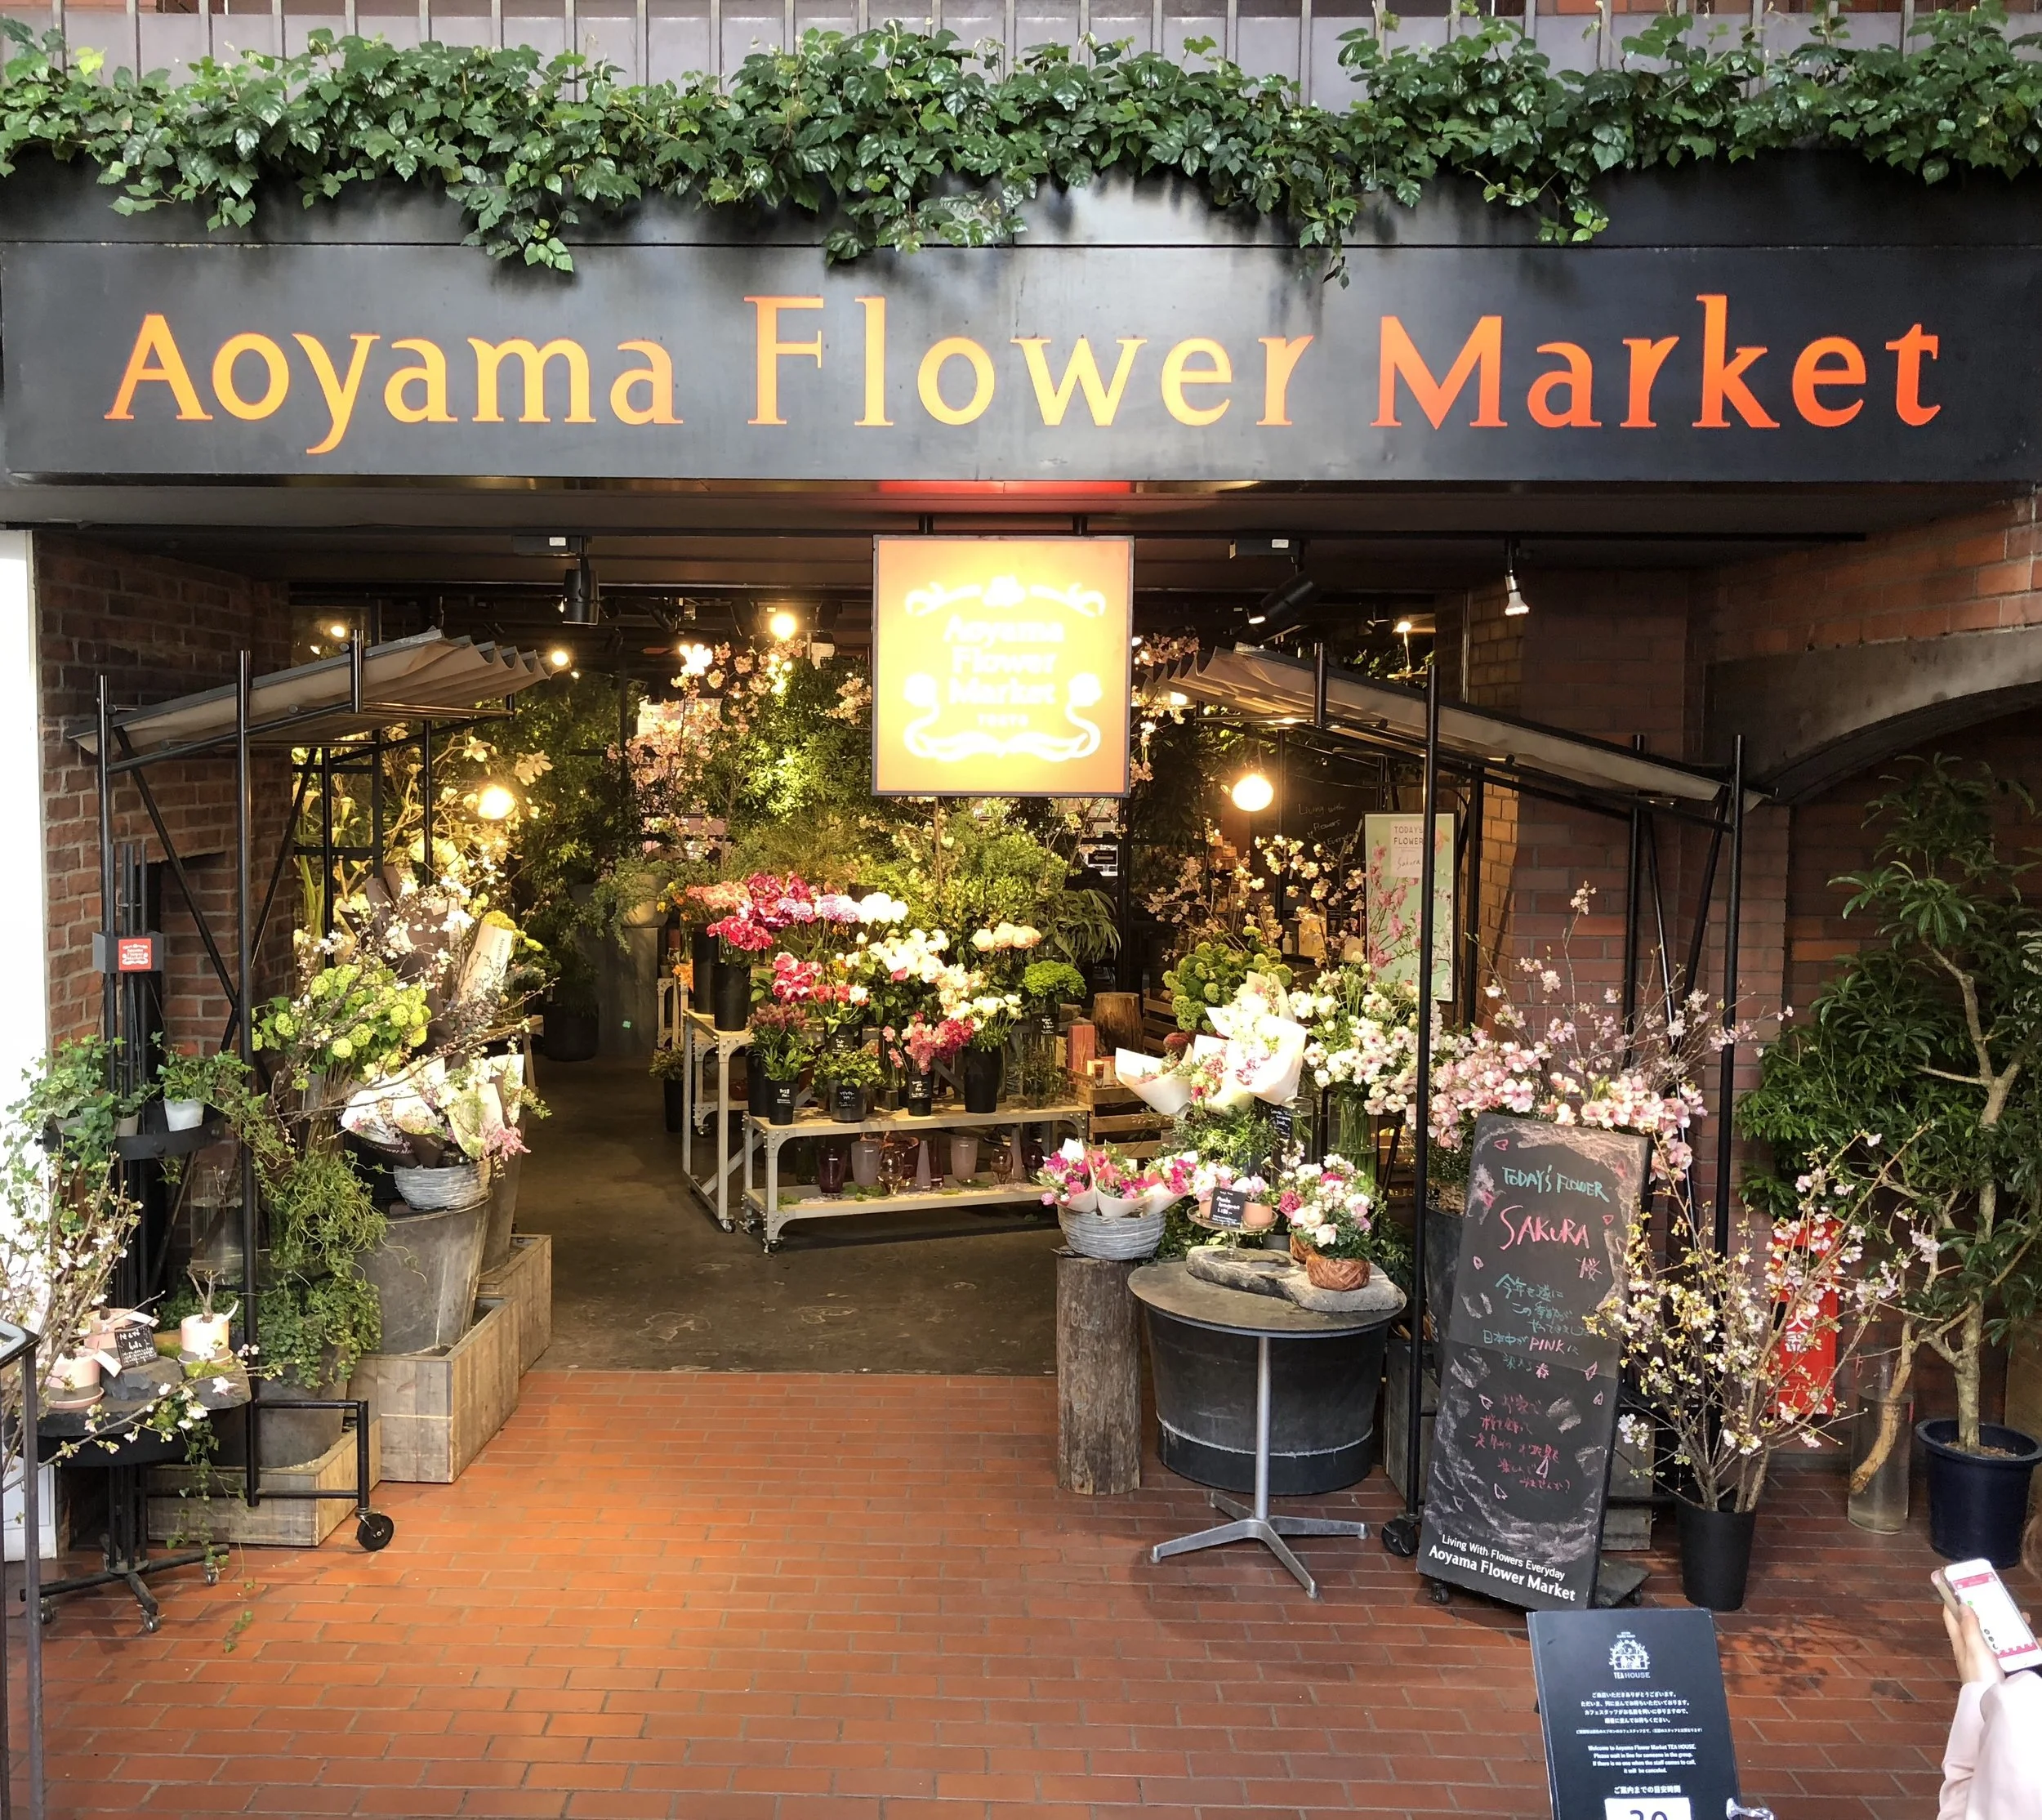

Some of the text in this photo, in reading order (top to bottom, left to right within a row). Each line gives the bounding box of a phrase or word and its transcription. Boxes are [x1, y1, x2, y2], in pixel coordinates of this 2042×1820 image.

[105, 293, 1942, 455] Aoyama Flower Market
[943, 613, 1065, 648] Aoyama
[951, 646, 1058, 674] Flower
[948, 676, 1057, 704] Market
[1298, 803, 1346, 818] Living with
[1326, 831, 1355, 845] Everyda
[1556, 1172, 1611, 1203] FLOWER
[1499, 1205, 1590, 1251] SAKURA
[1576, 1257, 1603, 1281] 桜
[1442, 1534, 1565, 1581] Living With Flowers Everyday
[1429, 1545, 1576, 1602] Aoyama Flower Market
[1614, 1785, 1681, 1794] ご案内までの目安時間
